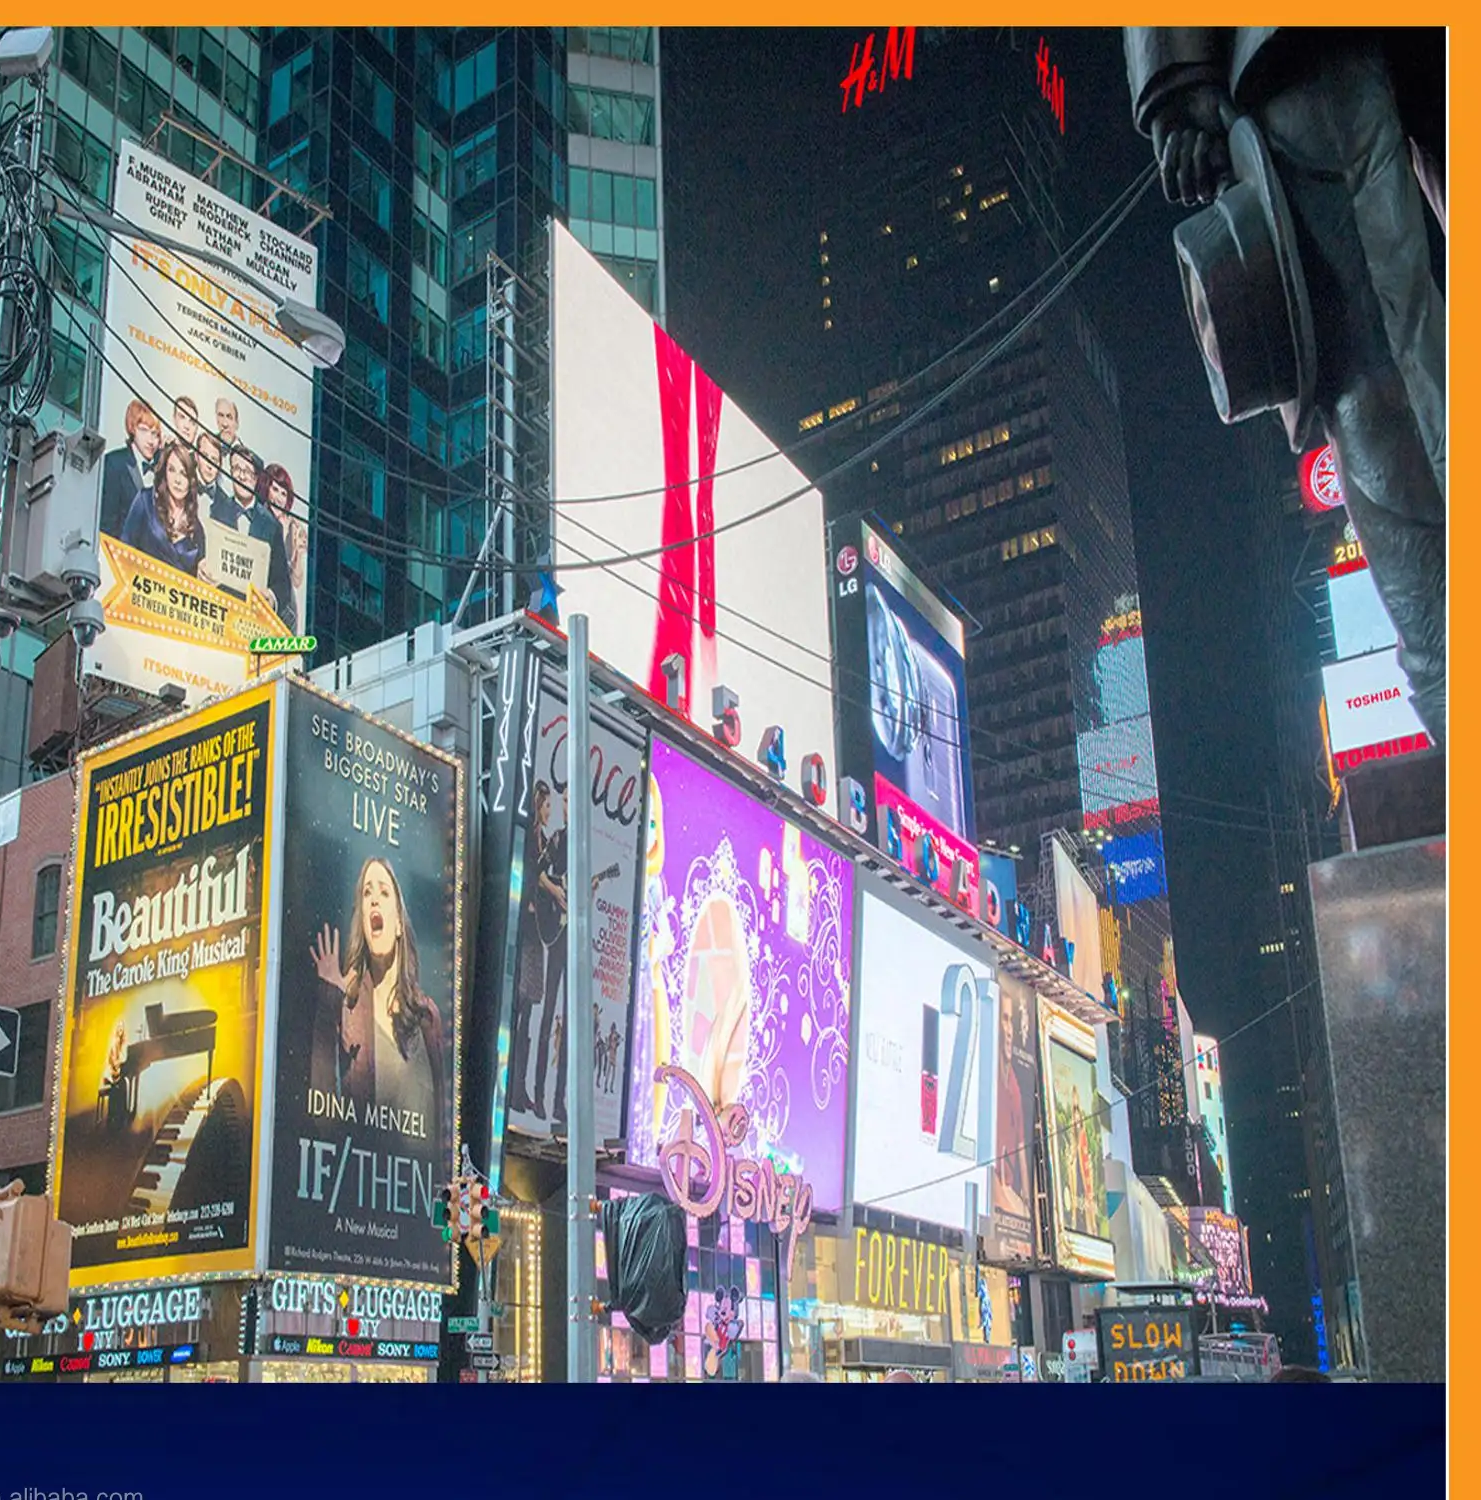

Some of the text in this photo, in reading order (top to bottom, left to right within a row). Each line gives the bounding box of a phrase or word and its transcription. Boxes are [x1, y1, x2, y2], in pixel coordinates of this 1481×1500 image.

[840, 26, 916, 113] H&M
[127, 166, 185, 205] ABRAHAM
[140, 162, 186, 193] MURRAY
[146, 191, 188, 221] RUPERT
[150, 205, 183, 231] GRINT
[193, 202, 251, 242] BRODERICK
[197, 193, 249, 229] MATTHEW
[198, 220, 241, 252] NATHAN
[205, 236, 232, 258] LANE
[260, 229, 313, 265] STOCKARD
[246, 257, 297, 292] MULLALLY
[254, 251, 290, 278] MEGAN
[260, 241, 311, 275] CHANNING
[175, 266, 229, 313] ONLY
[230, 299, 245, 322] A
[176, 302, 218, 331] TERRENCE
[187, 327, 246, 362] JACK O'BRIEN
[131, 592, 167, 616] BETWEEN
[168, 587, 228, 622] STREET
[839, 578, 859, 598] LG
[254, 636, 310, 651] LAMAR
[1346, 687, 1401, 710] TOSHIBA
[661, 653, 827, 806] 1540
[145, 755, 170, 787] JOINS
[172, 748, 188, 777] THE
[190, 735, 221, 770] RANKS
[223, 729, 237, 758] OF
[237, 721, 255, 752] THE
[311, 714, 440, 794] SEE BROADWAY'S
[1334, 732, 1430, 771] TOSHIBA
[324, 747, 428, 815] BIGGEST STAR
[352, 792, 402, 847] LIVE
[89, 843, 250, 962] Beautiful
[87, 929, 247, 998] The Carole King Musical
[307, 1089, 427, 1139] IDINA MENZEL
[297, 1135, 434, 1218] IF/THEN
[334, 1217, 399, 1240] A New Musical
[854, 1227, 949, 1315] FOREVER
[85, 1286, 202, 1330] LUGGAGE
[272, 1278, 443, 1323] GIFTS LUGGAGE
[282, 1339, 300, 1353] Apple
[306, 1338, 334, 1355] Nikon
[338, 1340, 373, 1356] Canon
[377, 1344, 410, 1358] SONY
[1110, 1322, 1183, 1349] SLOW
[30, 1357, 54, 1372] Nikon
[59, 1355, 92, 1372] Canon
[98, 1352, 131, 1367] SONY
[1114, 1361, 1185, 1383] DOWN
